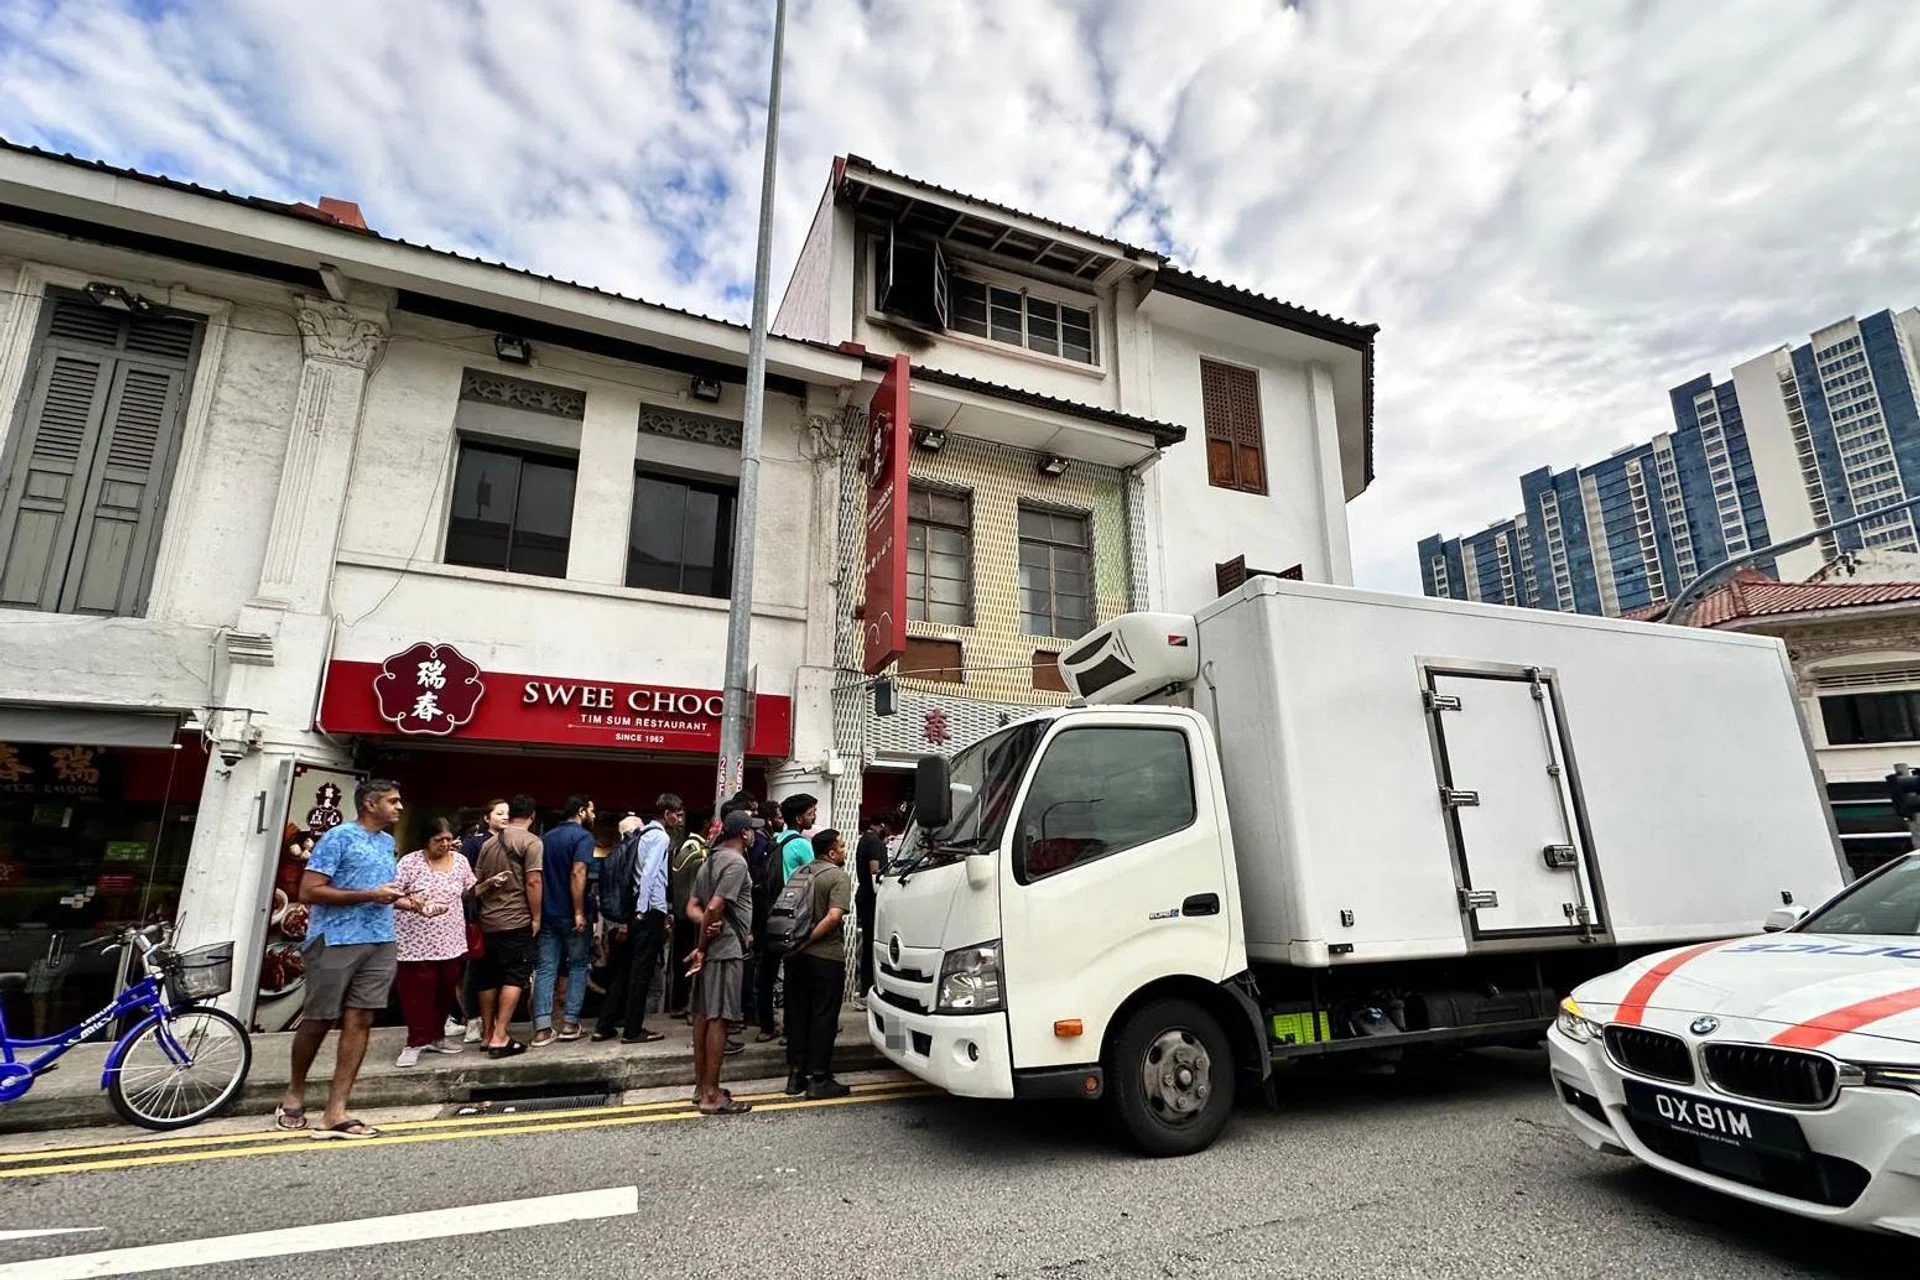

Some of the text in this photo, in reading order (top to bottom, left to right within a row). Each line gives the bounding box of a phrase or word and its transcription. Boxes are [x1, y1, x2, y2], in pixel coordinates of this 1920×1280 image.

[410, 659, 447, 722] 瑞春
[523, 681, 724, 717] SWEE CHOO
[580, 714, 708, 731] TIM SUM RESTAURANT
[615, 733, 665, 744] SINCE 1962
[1656, 1094, 1753, 1139] QX81M
